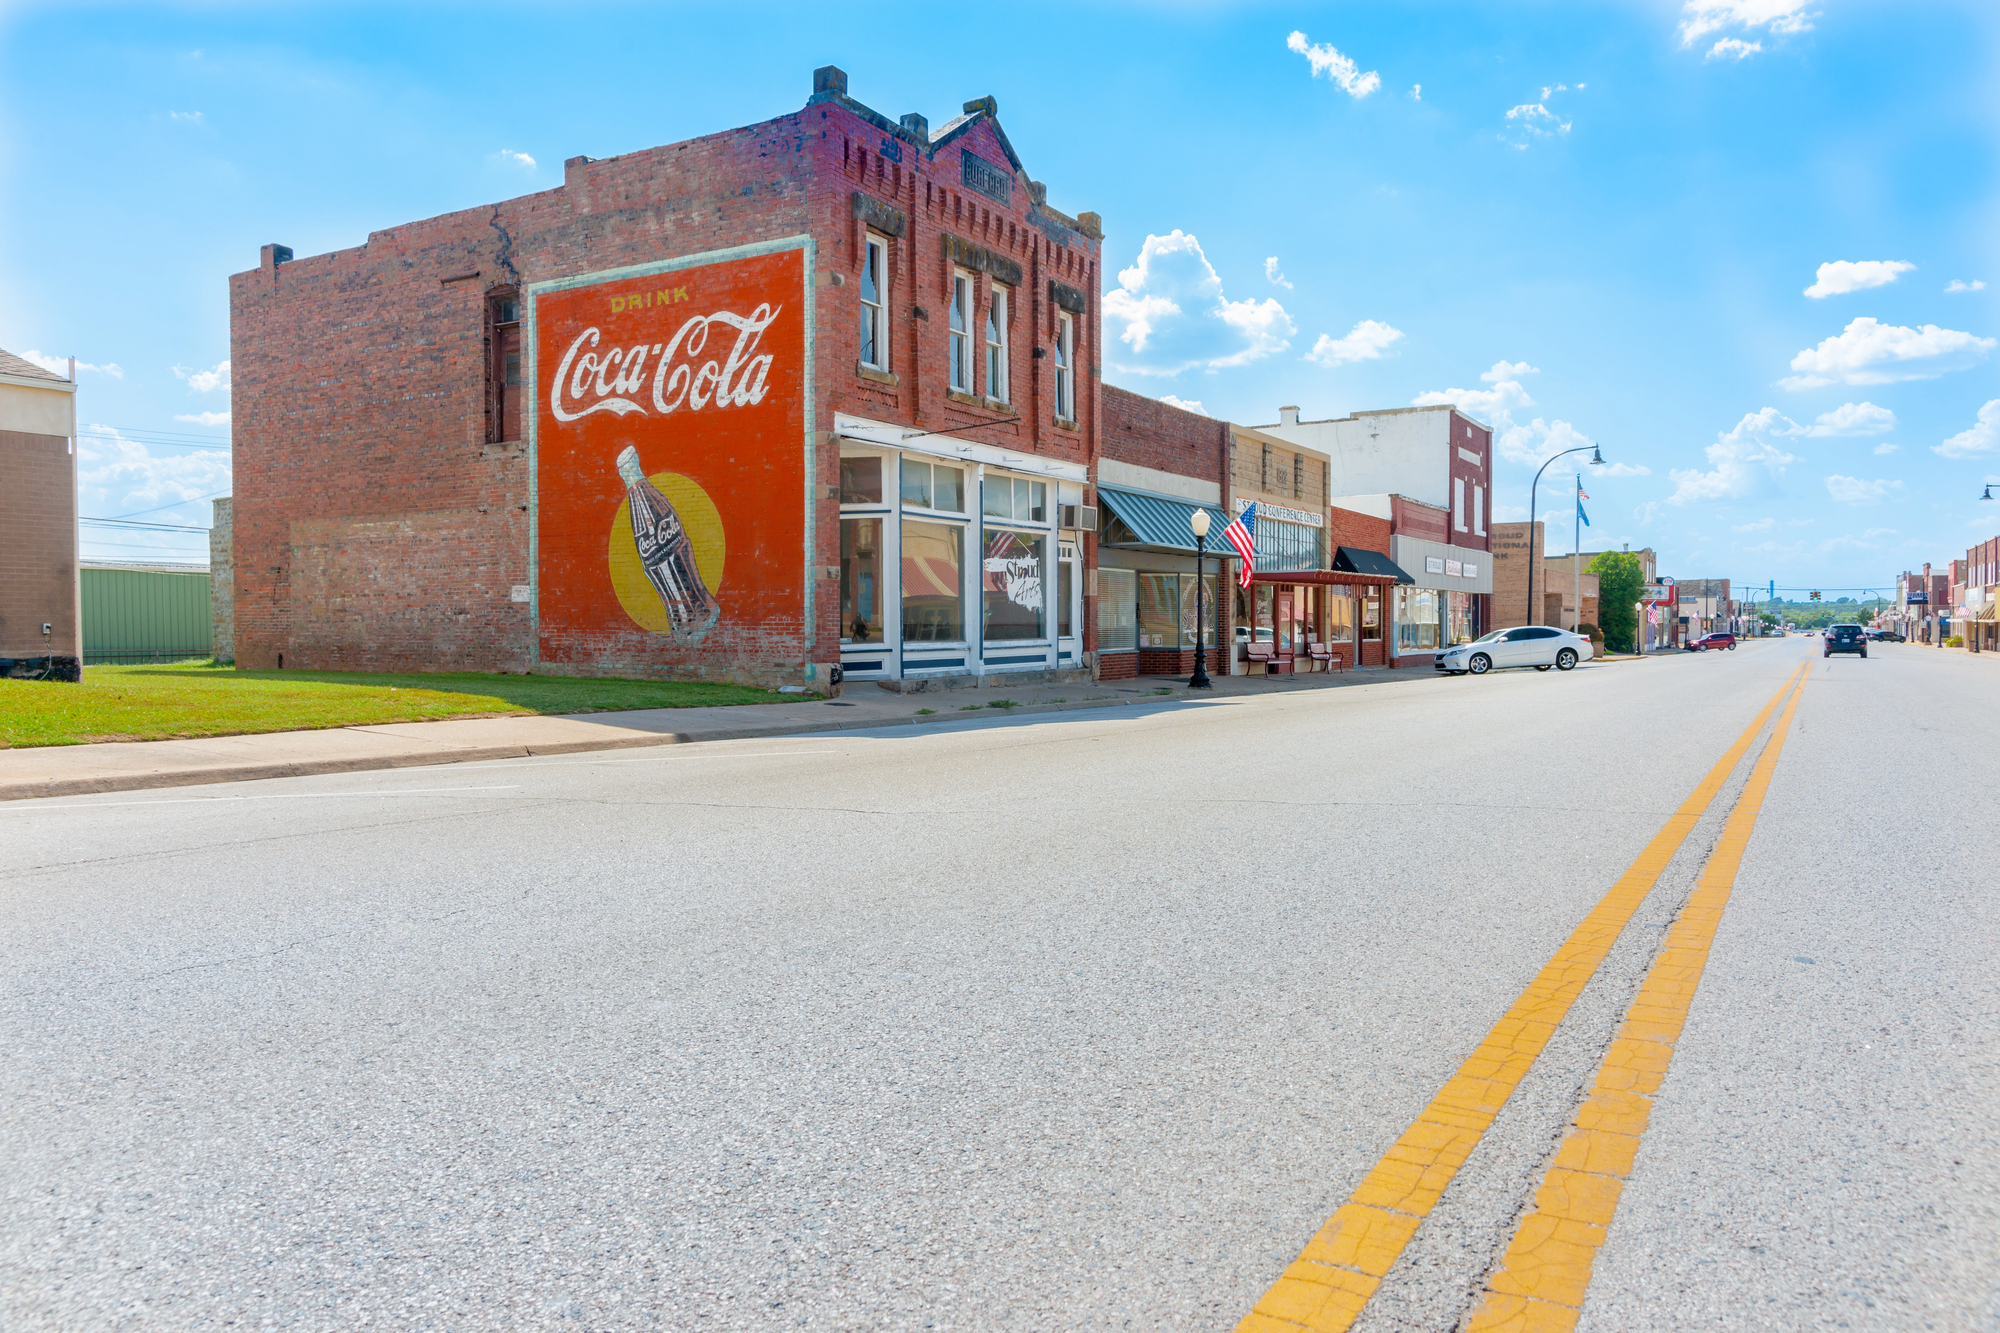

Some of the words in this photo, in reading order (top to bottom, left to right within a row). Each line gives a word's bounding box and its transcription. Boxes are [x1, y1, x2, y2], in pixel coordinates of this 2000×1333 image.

[965, 159, 1008, 200] BURFORD
[610, 285, 689, 313] DRINK
[551, 302, 783, 422] Coca-Cola
[1243, 500, 1266, 515] STOUD
[1268, 504, 1303, 522] CONFERENCE
[1304, 512, 1322, 525] CENTER
[639, 536, 659, 557] Coca
[657, 513, 680, 544] Cola
[1492, 532, 1524, 540] ROUD
[1006, 560, 1040, 585] Stroud
[1013, 580, 1040, 601] Arts
